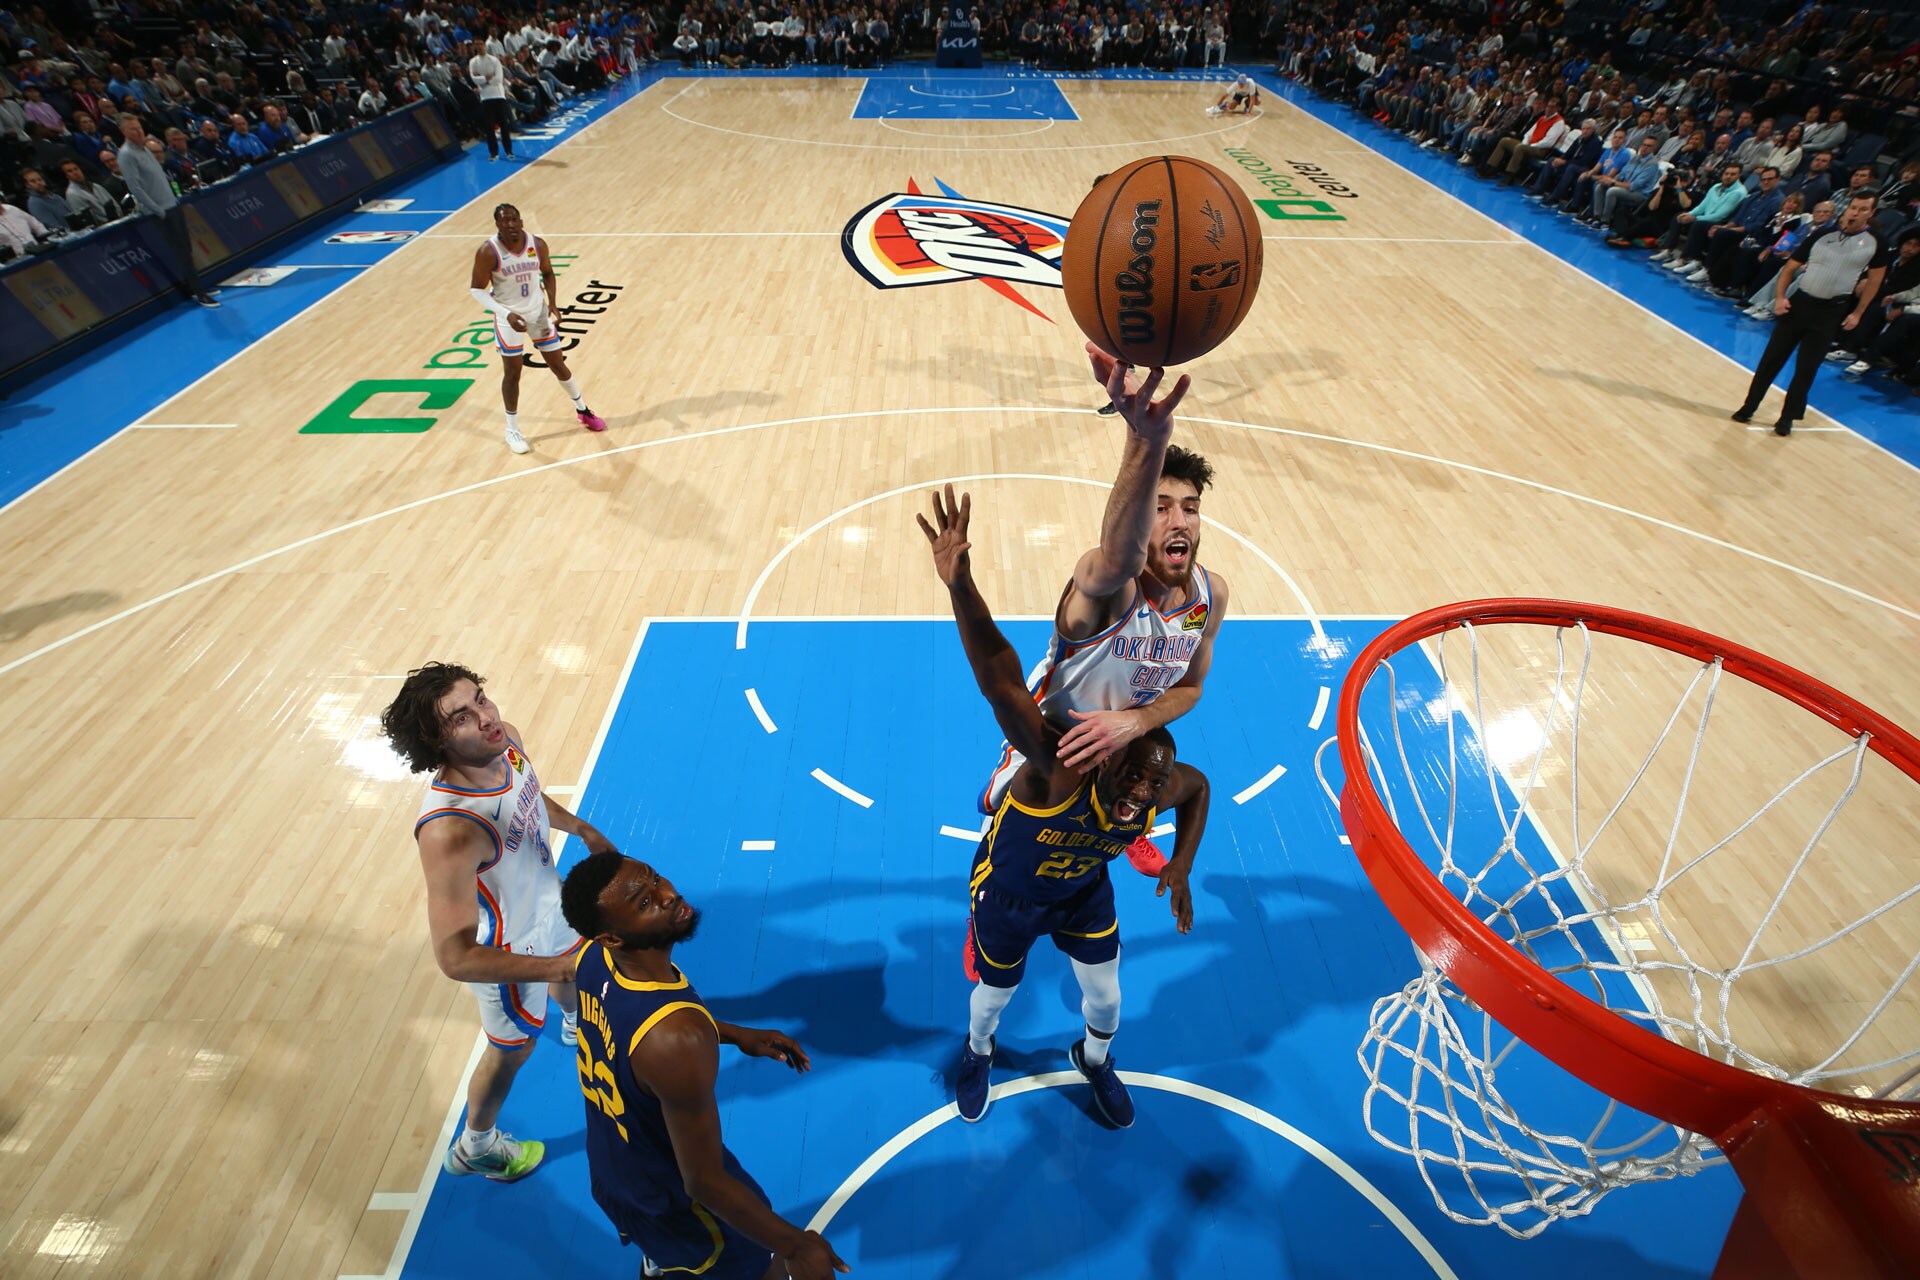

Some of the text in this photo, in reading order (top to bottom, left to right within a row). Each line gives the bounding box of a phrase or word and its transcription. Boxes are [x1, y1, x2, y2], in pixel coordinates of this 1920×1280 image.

[943, 37, 977, 48] KIA
[1223, 148, 1316, 197] paycom
[1285, 160, 1358, 198] center
[226, 196, 264, 219] ULTRA
[100, 247, 152, 275] ULTRA
[1115, 199, 1162, 345] Wilson
[515, 272, 531, 283] CITY
[521, 283, 529, 297] 8
[1111, 635, 1202, 662] OKLAHOM
[1130, 665, 1182, 688] CITY
[1131, 689, 1161, 706] 7
[505, 771, 540, 852] OKLAHOM
[1036, 828, 1096, 847] GOLDEN
[1035, 851, 1102, 879] 23
[576, 1026, 629, 1143] 22
